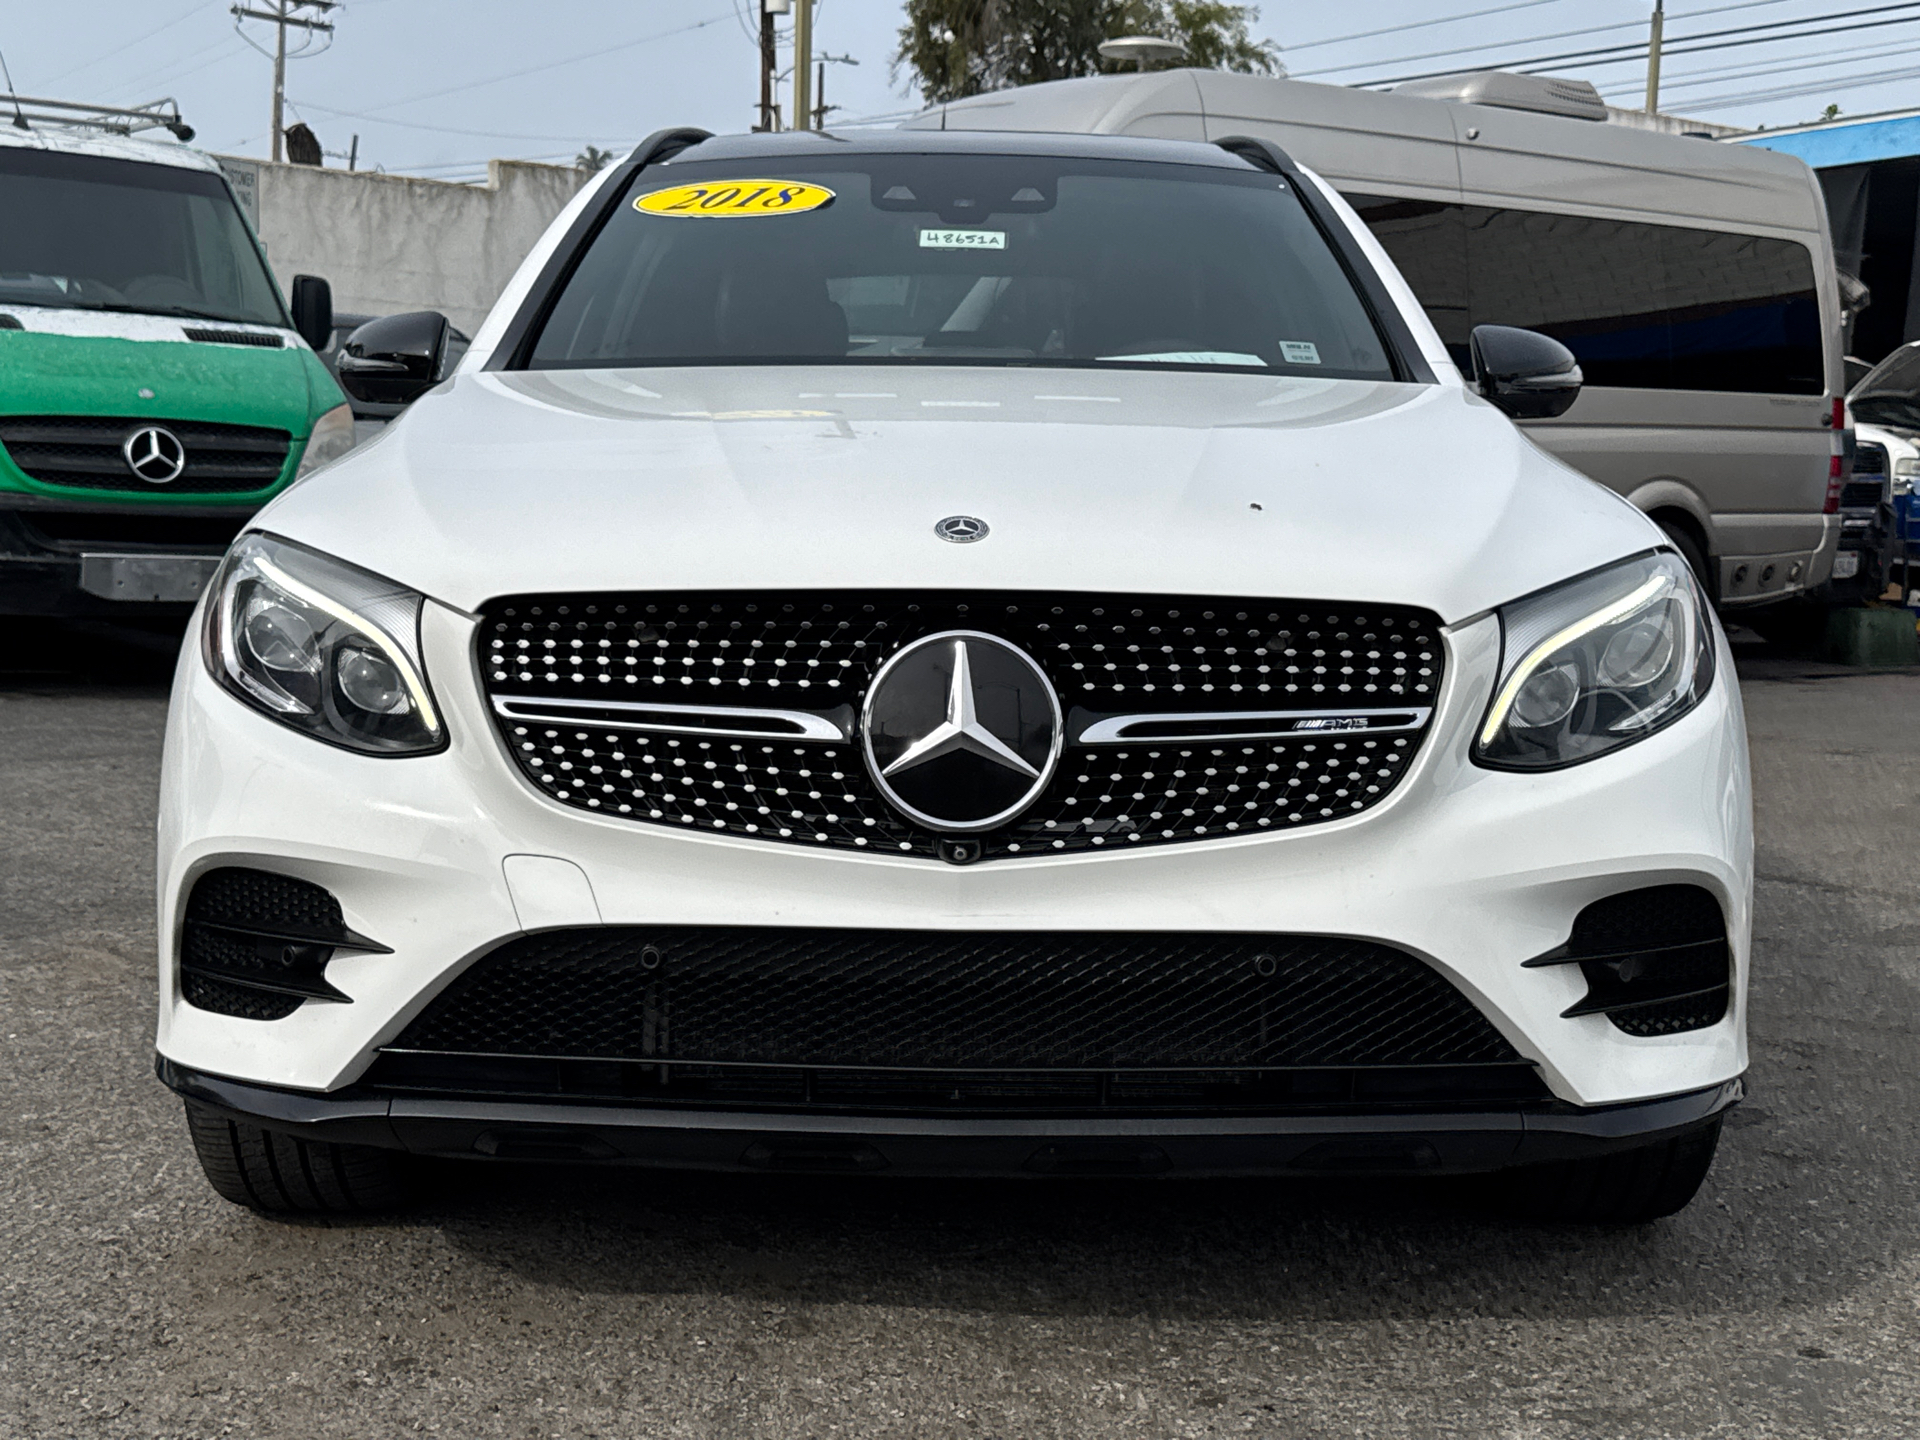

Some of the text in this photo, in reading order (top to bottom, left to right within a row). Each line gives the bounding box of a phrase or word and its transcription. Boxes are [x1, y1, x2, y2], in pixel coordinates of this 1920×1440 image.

[662, 186, 806, 211] 2018
[926, 231, 1000, 246] 48651A
[1320, 717, 1369, 728] AMG
